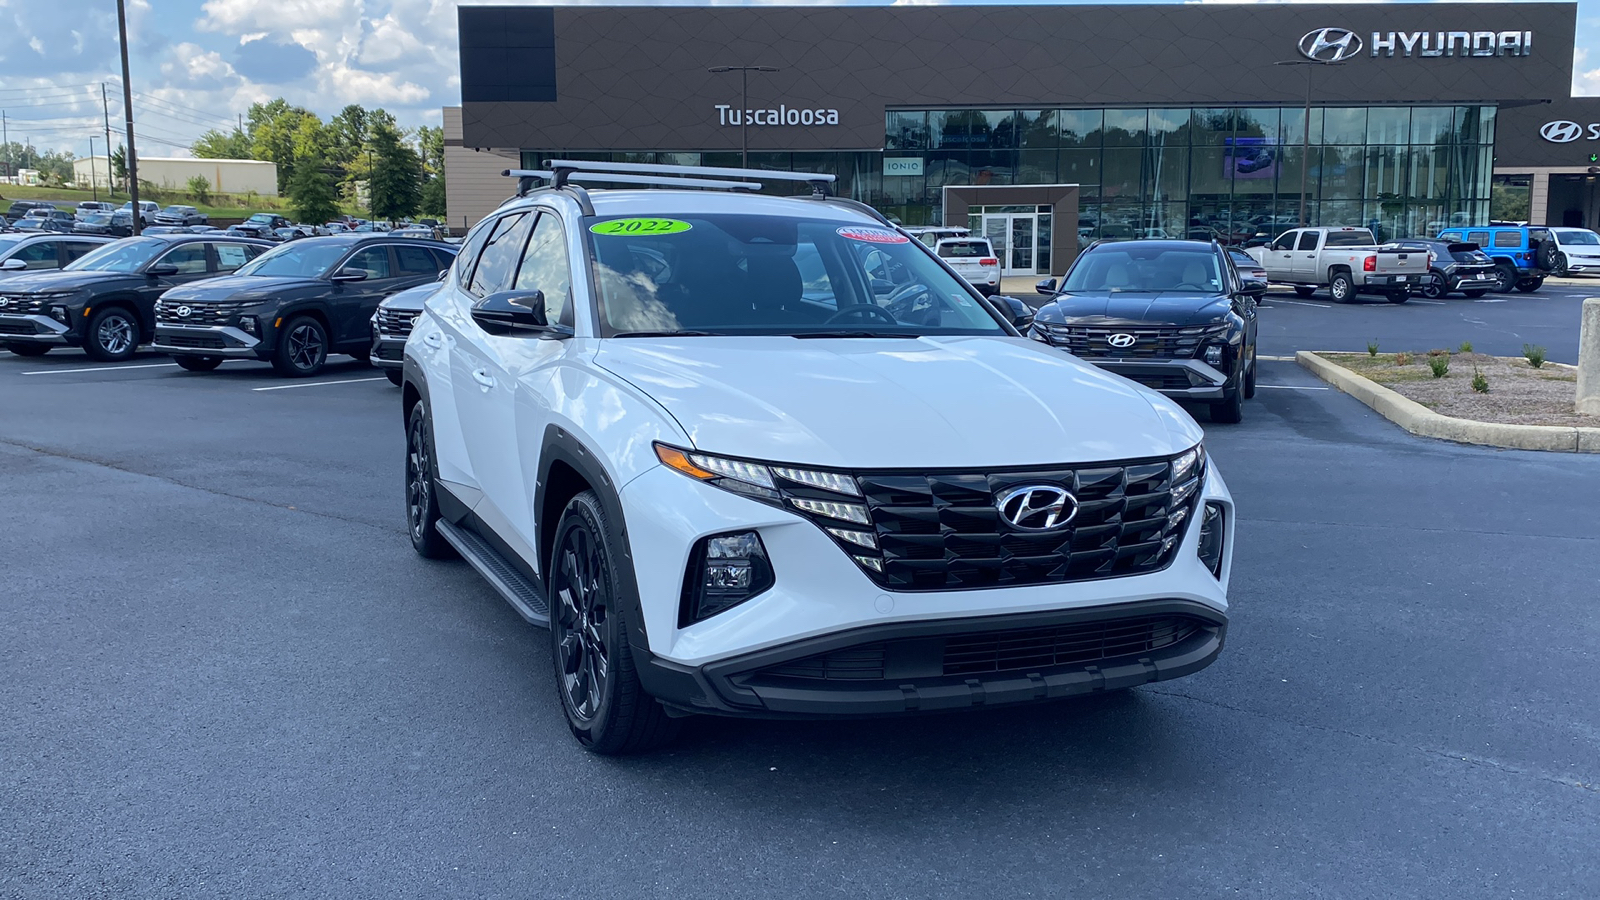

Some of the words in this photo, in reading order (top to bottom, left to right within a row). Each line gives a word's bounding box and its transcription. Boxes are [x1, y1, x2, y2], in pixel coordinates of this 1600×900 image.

[1371, 30, 1532, 57] HYUNDAI
[714, 104, 839, 126] Tuscaloosa
[1586, 123, 1600, 140] S
[608, 220, 674, 233] 2022
